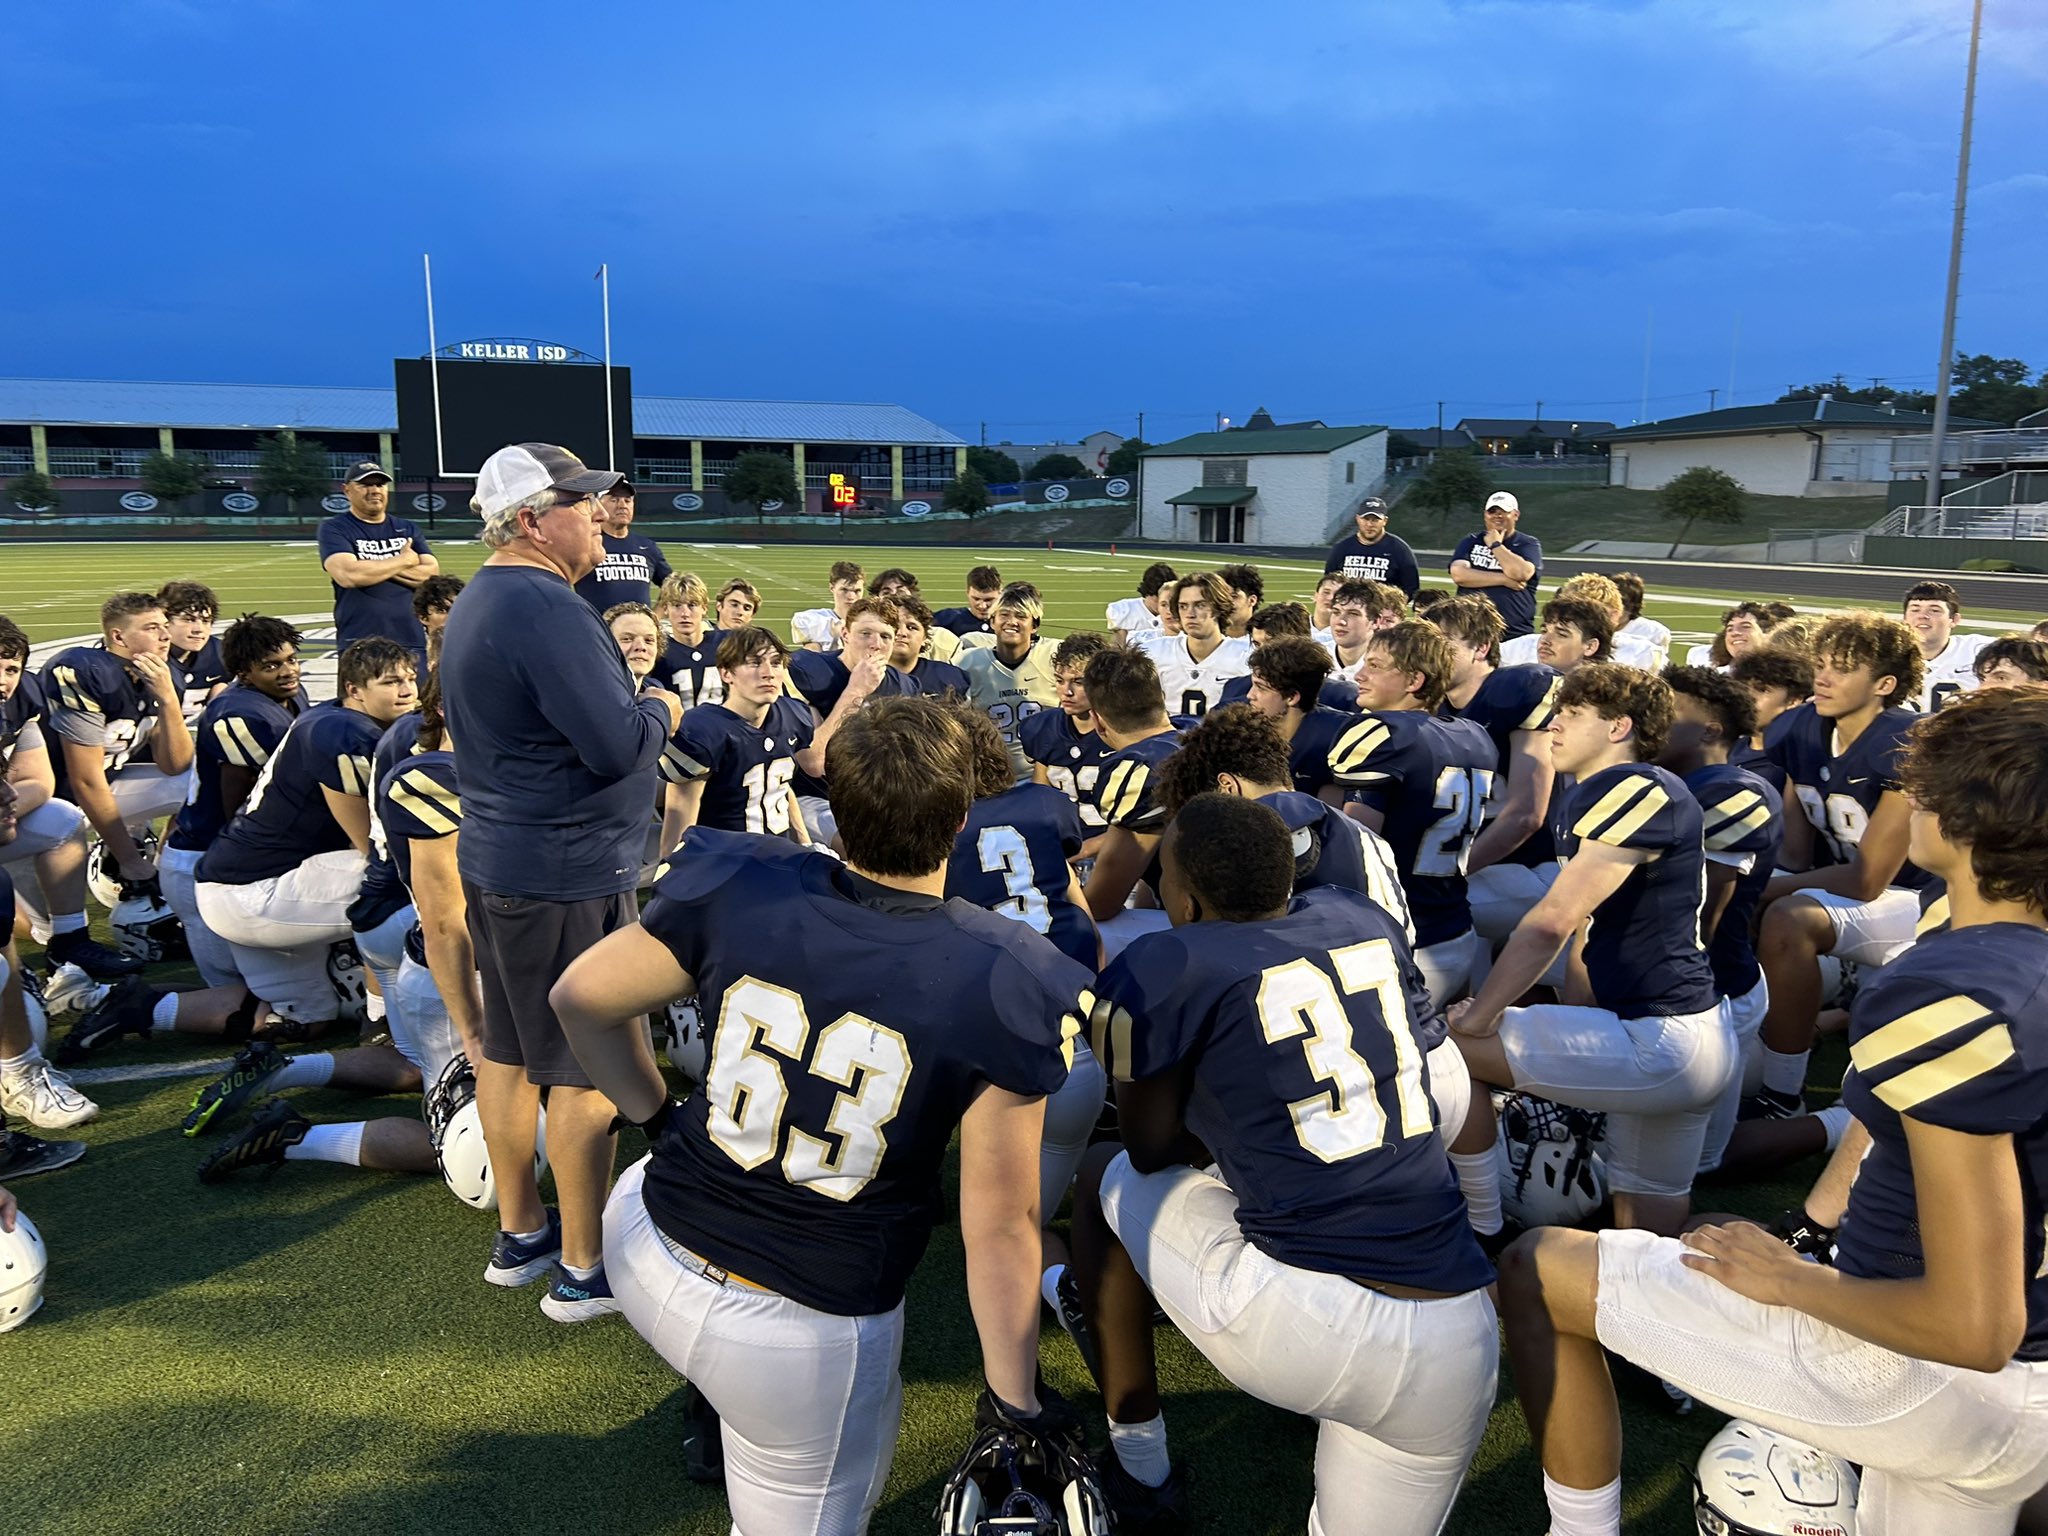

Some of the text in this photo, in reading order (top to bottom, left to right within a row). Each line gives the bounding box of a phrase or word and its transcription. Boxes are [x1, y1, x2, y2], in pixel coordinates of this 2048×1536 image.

[461, 343, 567, 360] KELLER ISD
[833, 486, 855, 502] 02
[1343, 555, 1390, 570] KELLER
[594, 565, 651, 583] FOOTBALL
[1342, 566, 1388, 582] FOOTBALL
[672, 666, 725, 711] 14
[998, 688, 1029, 698] INDIANS
[742, 756, 796, 835] 16
[976, 825, 1053, 935] 3
[1256, 938, 1433, 1164] 37
[707, 975, 912, 1203] 63
[557, 1283, 590, 1300] HOKA
[1793, 1524, 1841, 1536] Riddell
